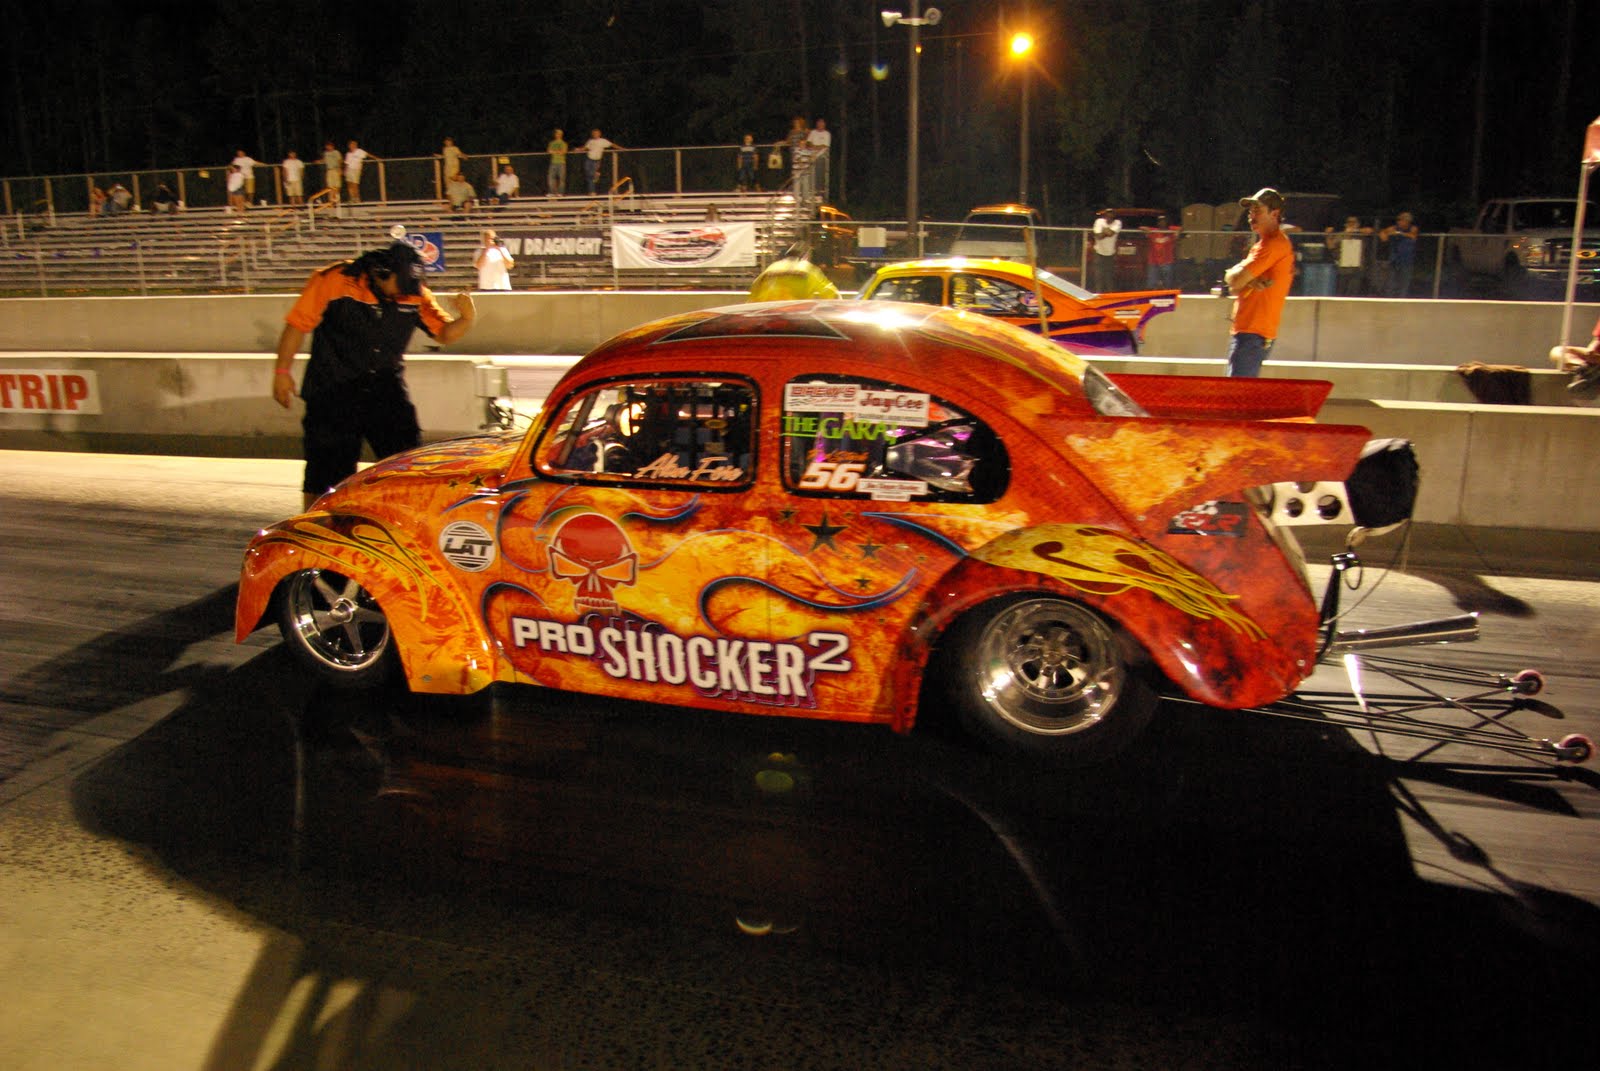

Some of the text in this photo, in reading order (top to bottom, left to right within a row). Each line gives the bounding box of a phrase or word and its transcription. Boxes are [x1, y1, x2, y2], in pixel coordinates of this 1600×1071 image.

[859, 392, 924, 413] JayCee
[782, 416, 819, 434] THE
[798, 461, 866, 491] 56
[443, 538, 493, 557] LAT
[512, 617, 595, 656] PRO
[600, 626, 807, 698] SHOCKER
